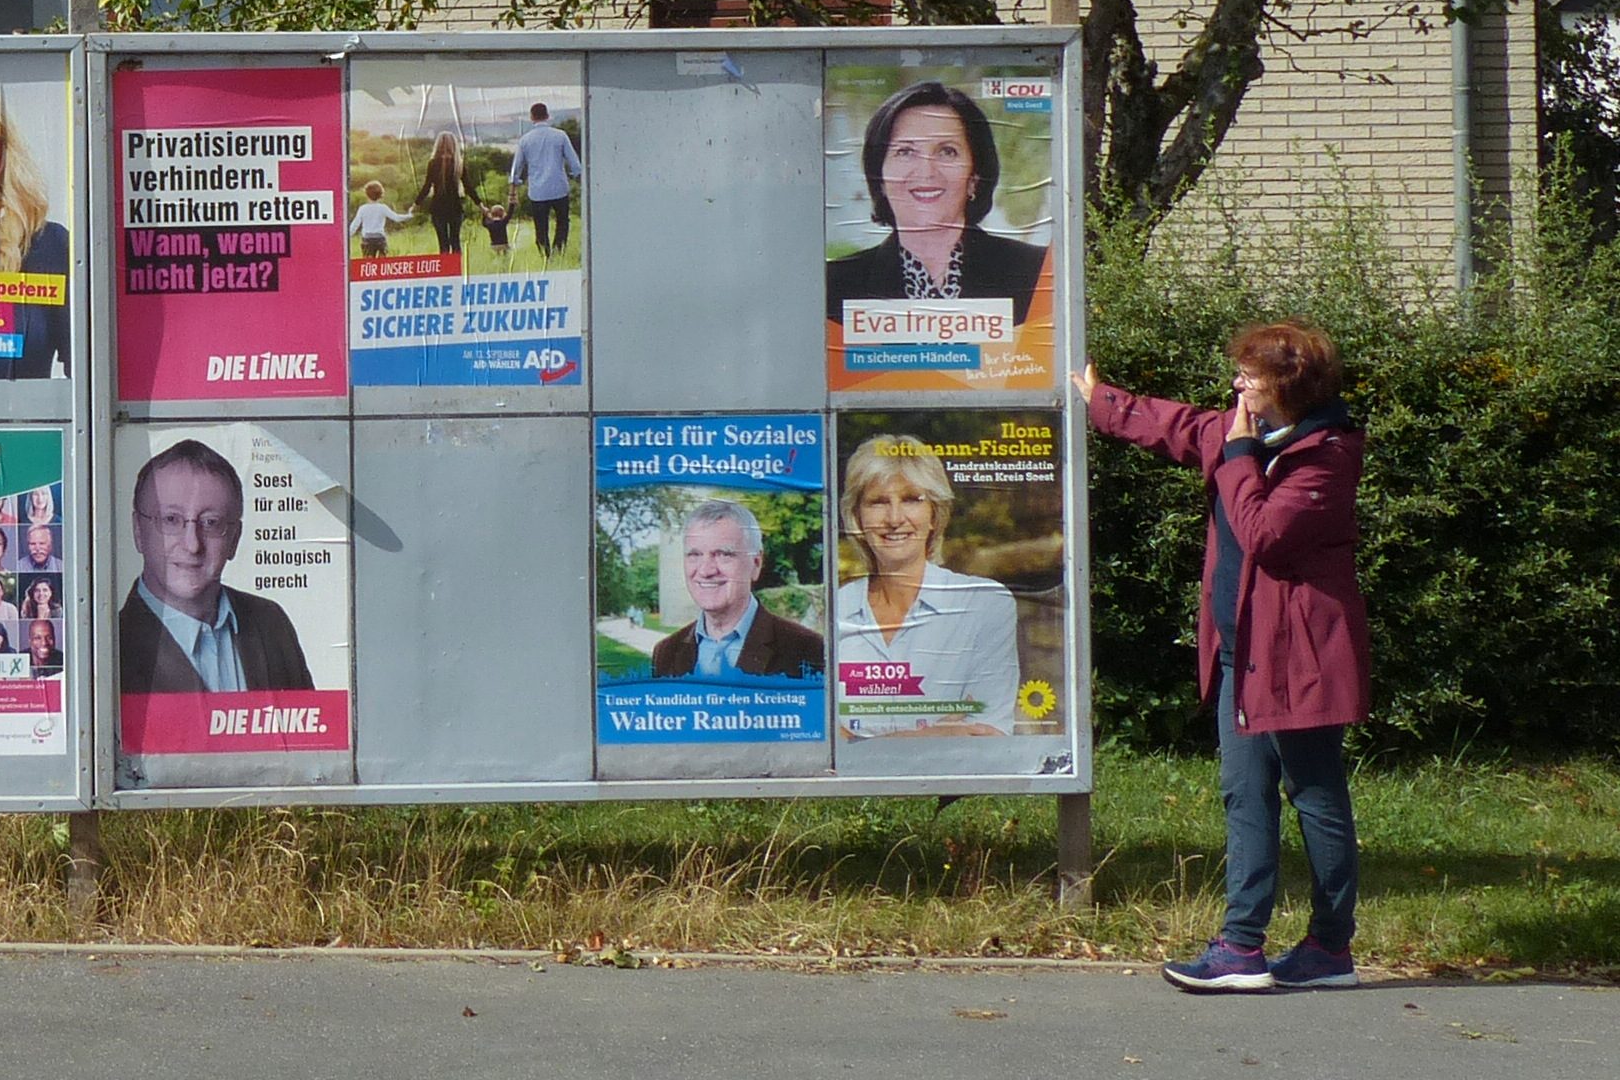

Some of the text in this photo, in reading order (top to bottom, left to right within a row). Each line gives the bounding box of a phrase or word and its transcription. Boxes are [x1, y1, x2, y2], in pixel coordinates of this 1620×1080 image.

[1007, 85, 1044, 97] CDU
[128, 131, 306, 159] Privatisierung
[129, 166, 273, 191] verhindern.
[130, 197, 327, 224] Klinikum retten.
[132, 230, 285, 258] Wann, wenn
[132, 261, 273, 294] nicht jetzt?
[361, 260, 441, 277] FÜR UNSERE LEUTE
[360, 280, 549, 312] SICHERE HEIMAT
[362, 307, 568, 339] SICHERE ZUKUNFT
[853, 311, 1003, 340] Eva Irrgang
[523, 350, 566, 369] AfD
[853, 352, 971, 364] In sicheren Händen.
[207, 356, 246, 381] DIE
[603, 424, 817, 447] Partei für Soziales
[1001, 422, 1052, 439] Ilona
[874, 439, 1053, 457] Kottmann-Fischer
[616, 455, 661, 475] und
[946, 461, 1054, 471] Landratskandidatin
[253, 473, 292, 490] Soest
[953, 472, 1054, 483] für den Kreis Soest
[254, 497, 309, 513] für alle:
[254, 526, 296, 541] sozial
[254, 549, 331, 567] ökologisch
[254, 574, 309, 591] gerecht
[865, 664, 908, 680] 13.09.
[859, 683, 902, 695] wählen!
[605, 692, 806, 707] Unser Kandidat für den Kreistag
[849, 704, 935, 713] Zukunft entscheidet
[209, 709, 247, 736] DIE
[610, 710, 801, 732] Walter Raubaum
